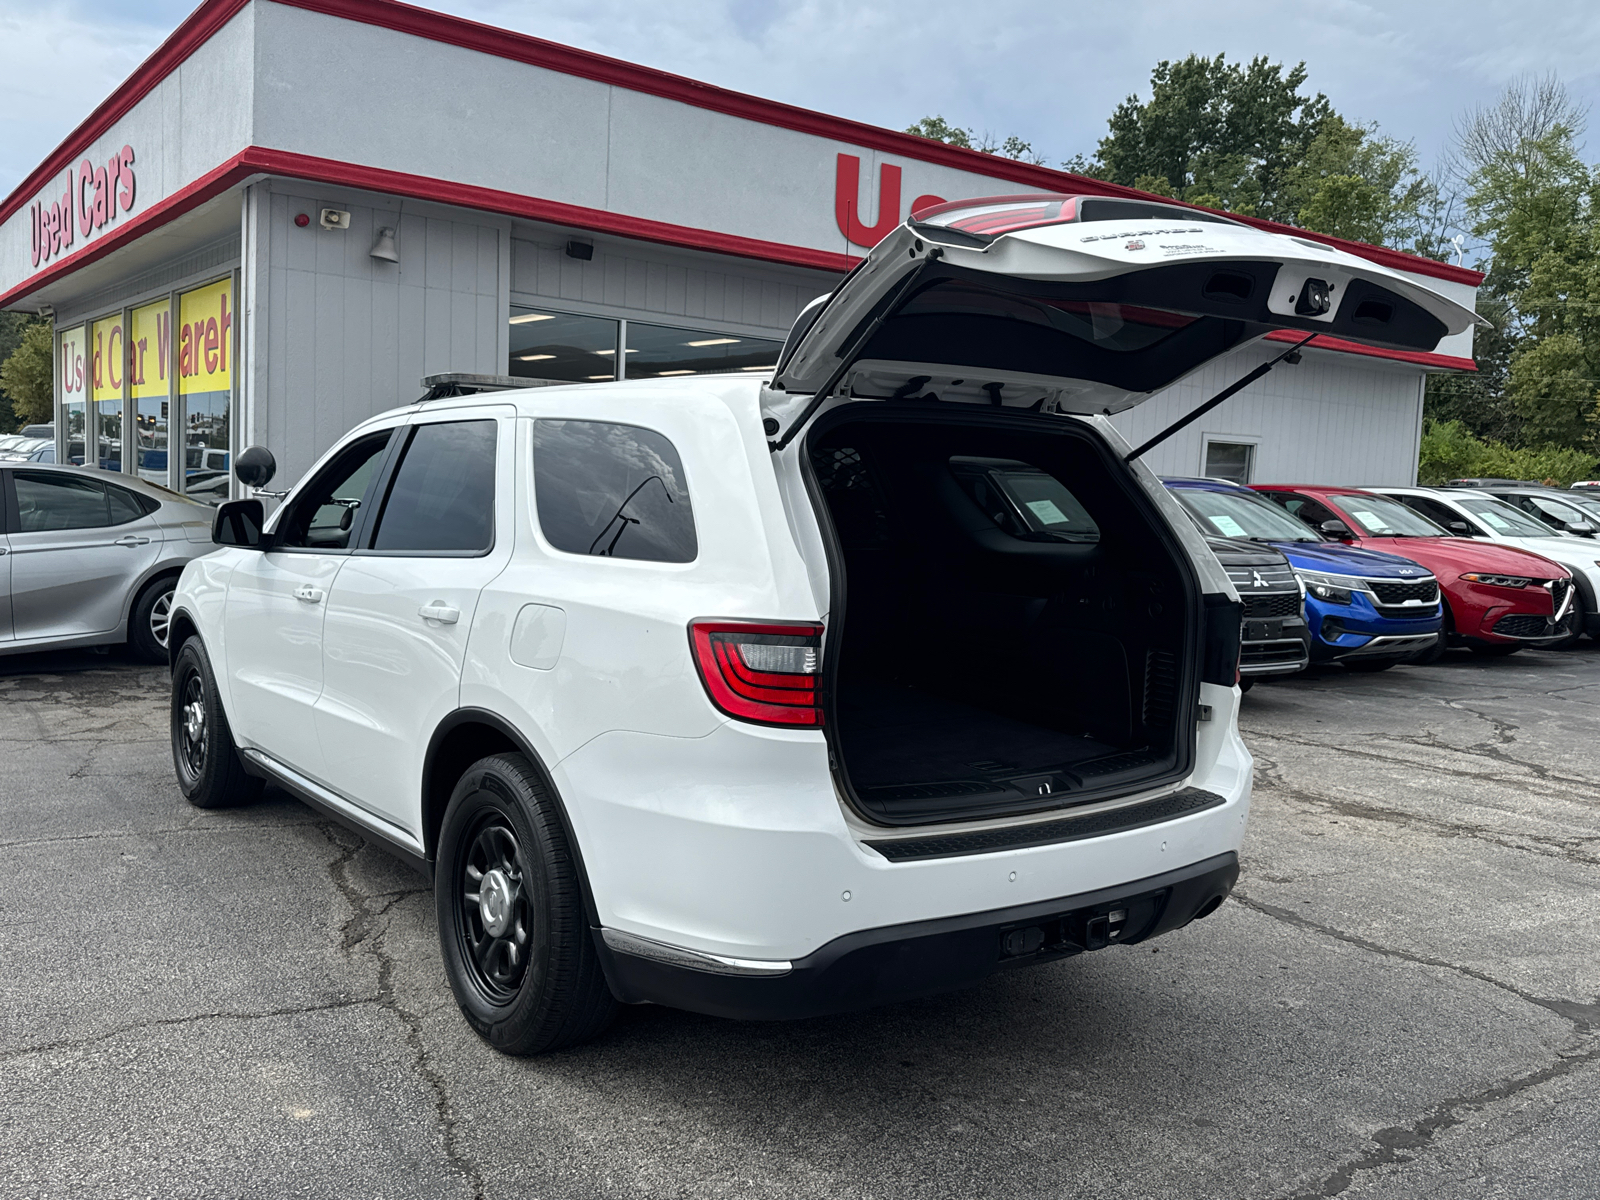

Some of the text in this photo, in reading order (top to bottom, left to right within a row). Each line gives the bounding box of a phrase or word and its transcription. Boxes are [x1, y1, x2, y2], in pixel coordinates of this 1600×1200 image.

[31, 144, 136, 268] Used Cars
[835, 152, 948, 248] U
